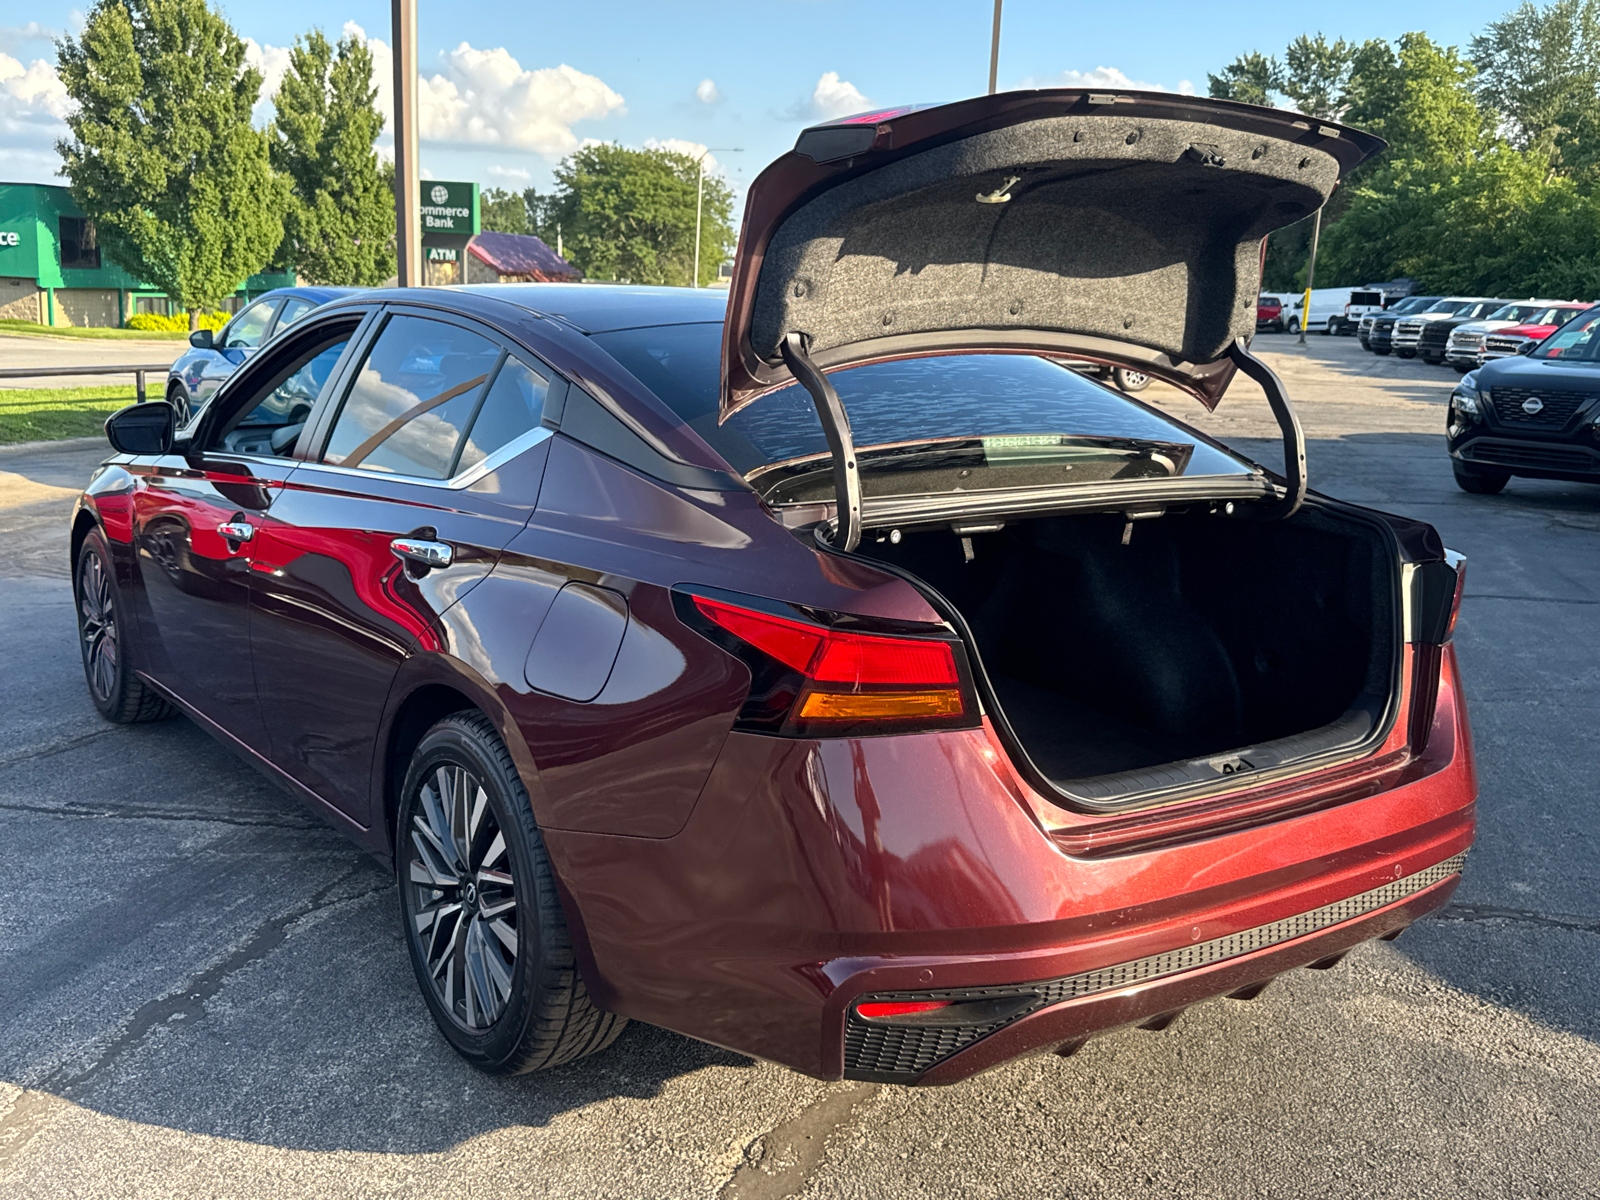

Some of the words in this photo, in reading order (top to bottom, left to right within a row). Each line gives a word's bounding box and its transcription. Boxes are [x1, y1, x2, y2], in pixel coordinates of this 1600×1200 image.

[420, 206, 470, 217] ommerce
[426, 216, 454, 228] Bank
[429, 248, 456, 260] ATM
